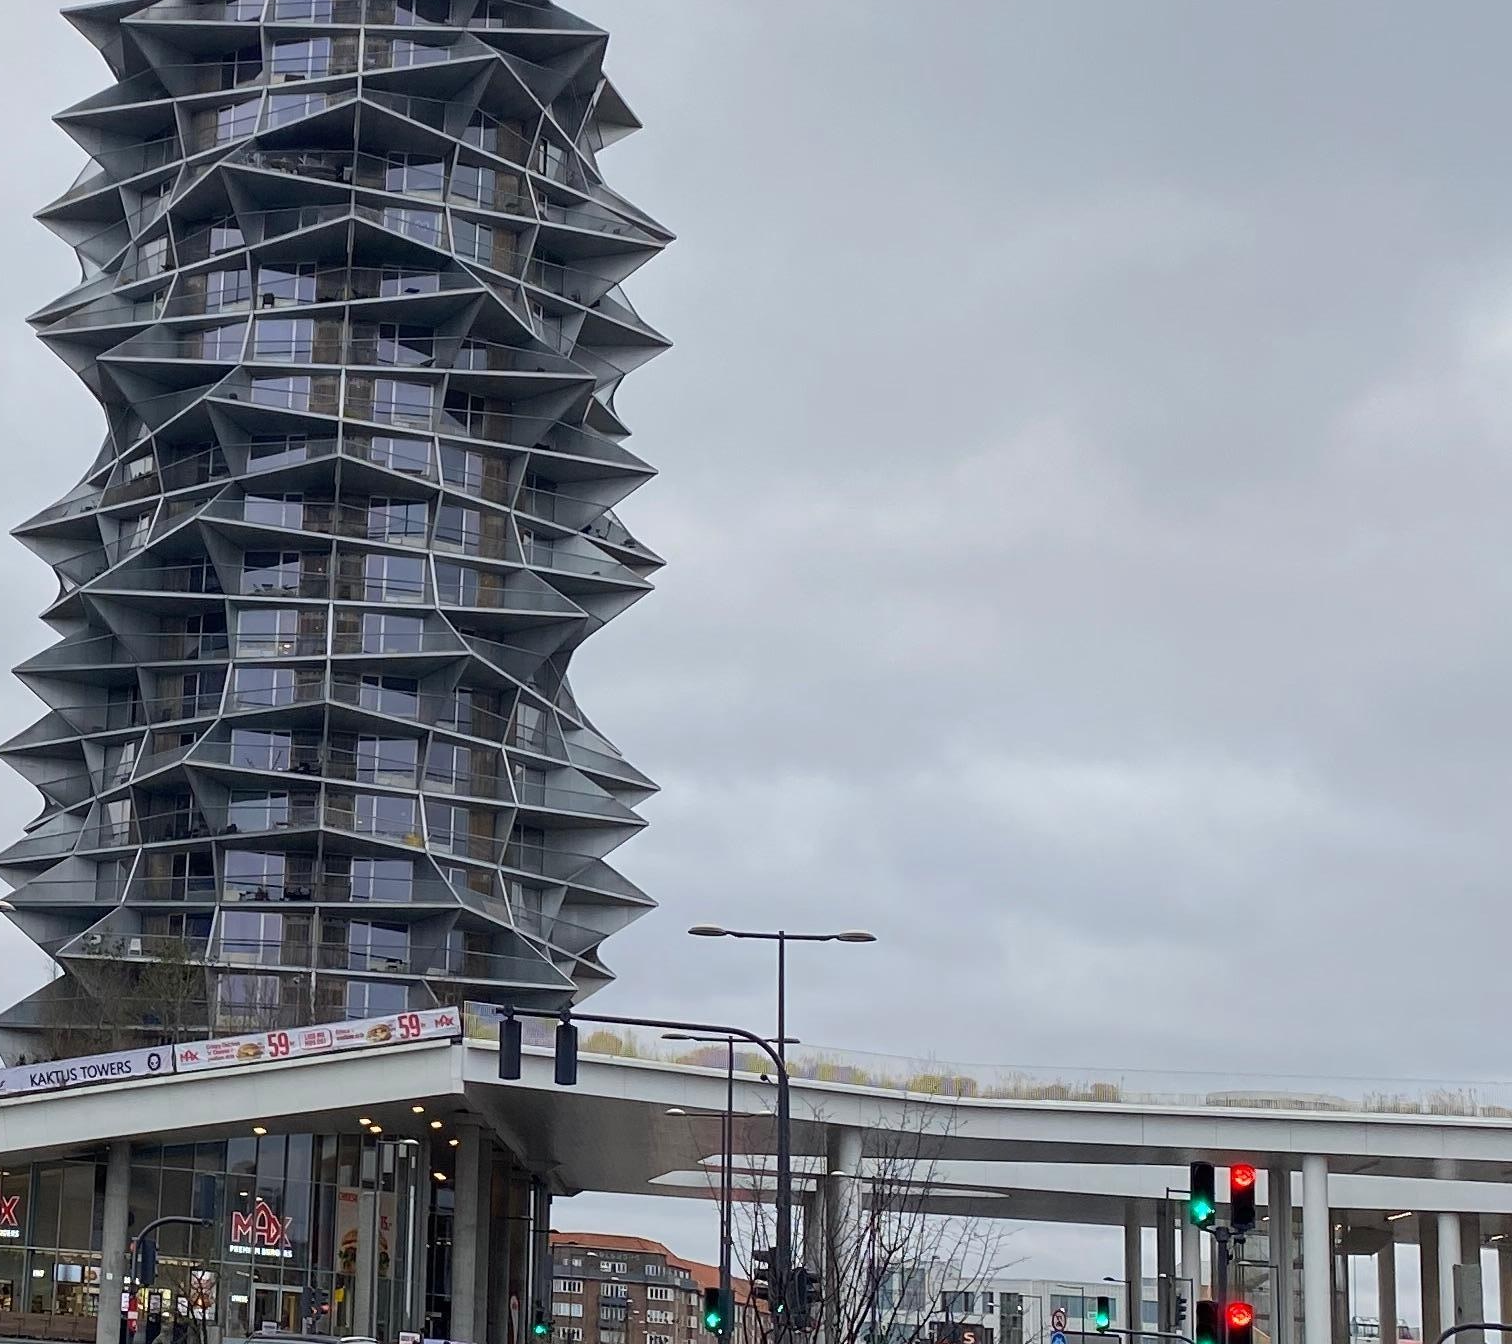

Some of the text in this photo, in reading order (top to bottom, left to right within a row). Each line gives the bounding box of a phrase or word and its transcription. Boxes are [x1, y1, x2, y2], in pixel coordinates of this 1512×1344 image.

[397, 1013, 421, 1039] 59
[267, 1032, 289, 1057] 59
[29, 1060, 132, 1087] KAKTUS TOWERS
[231, 1201, 293, 1248] MAX
[963, 1331, 975, 1344] S
